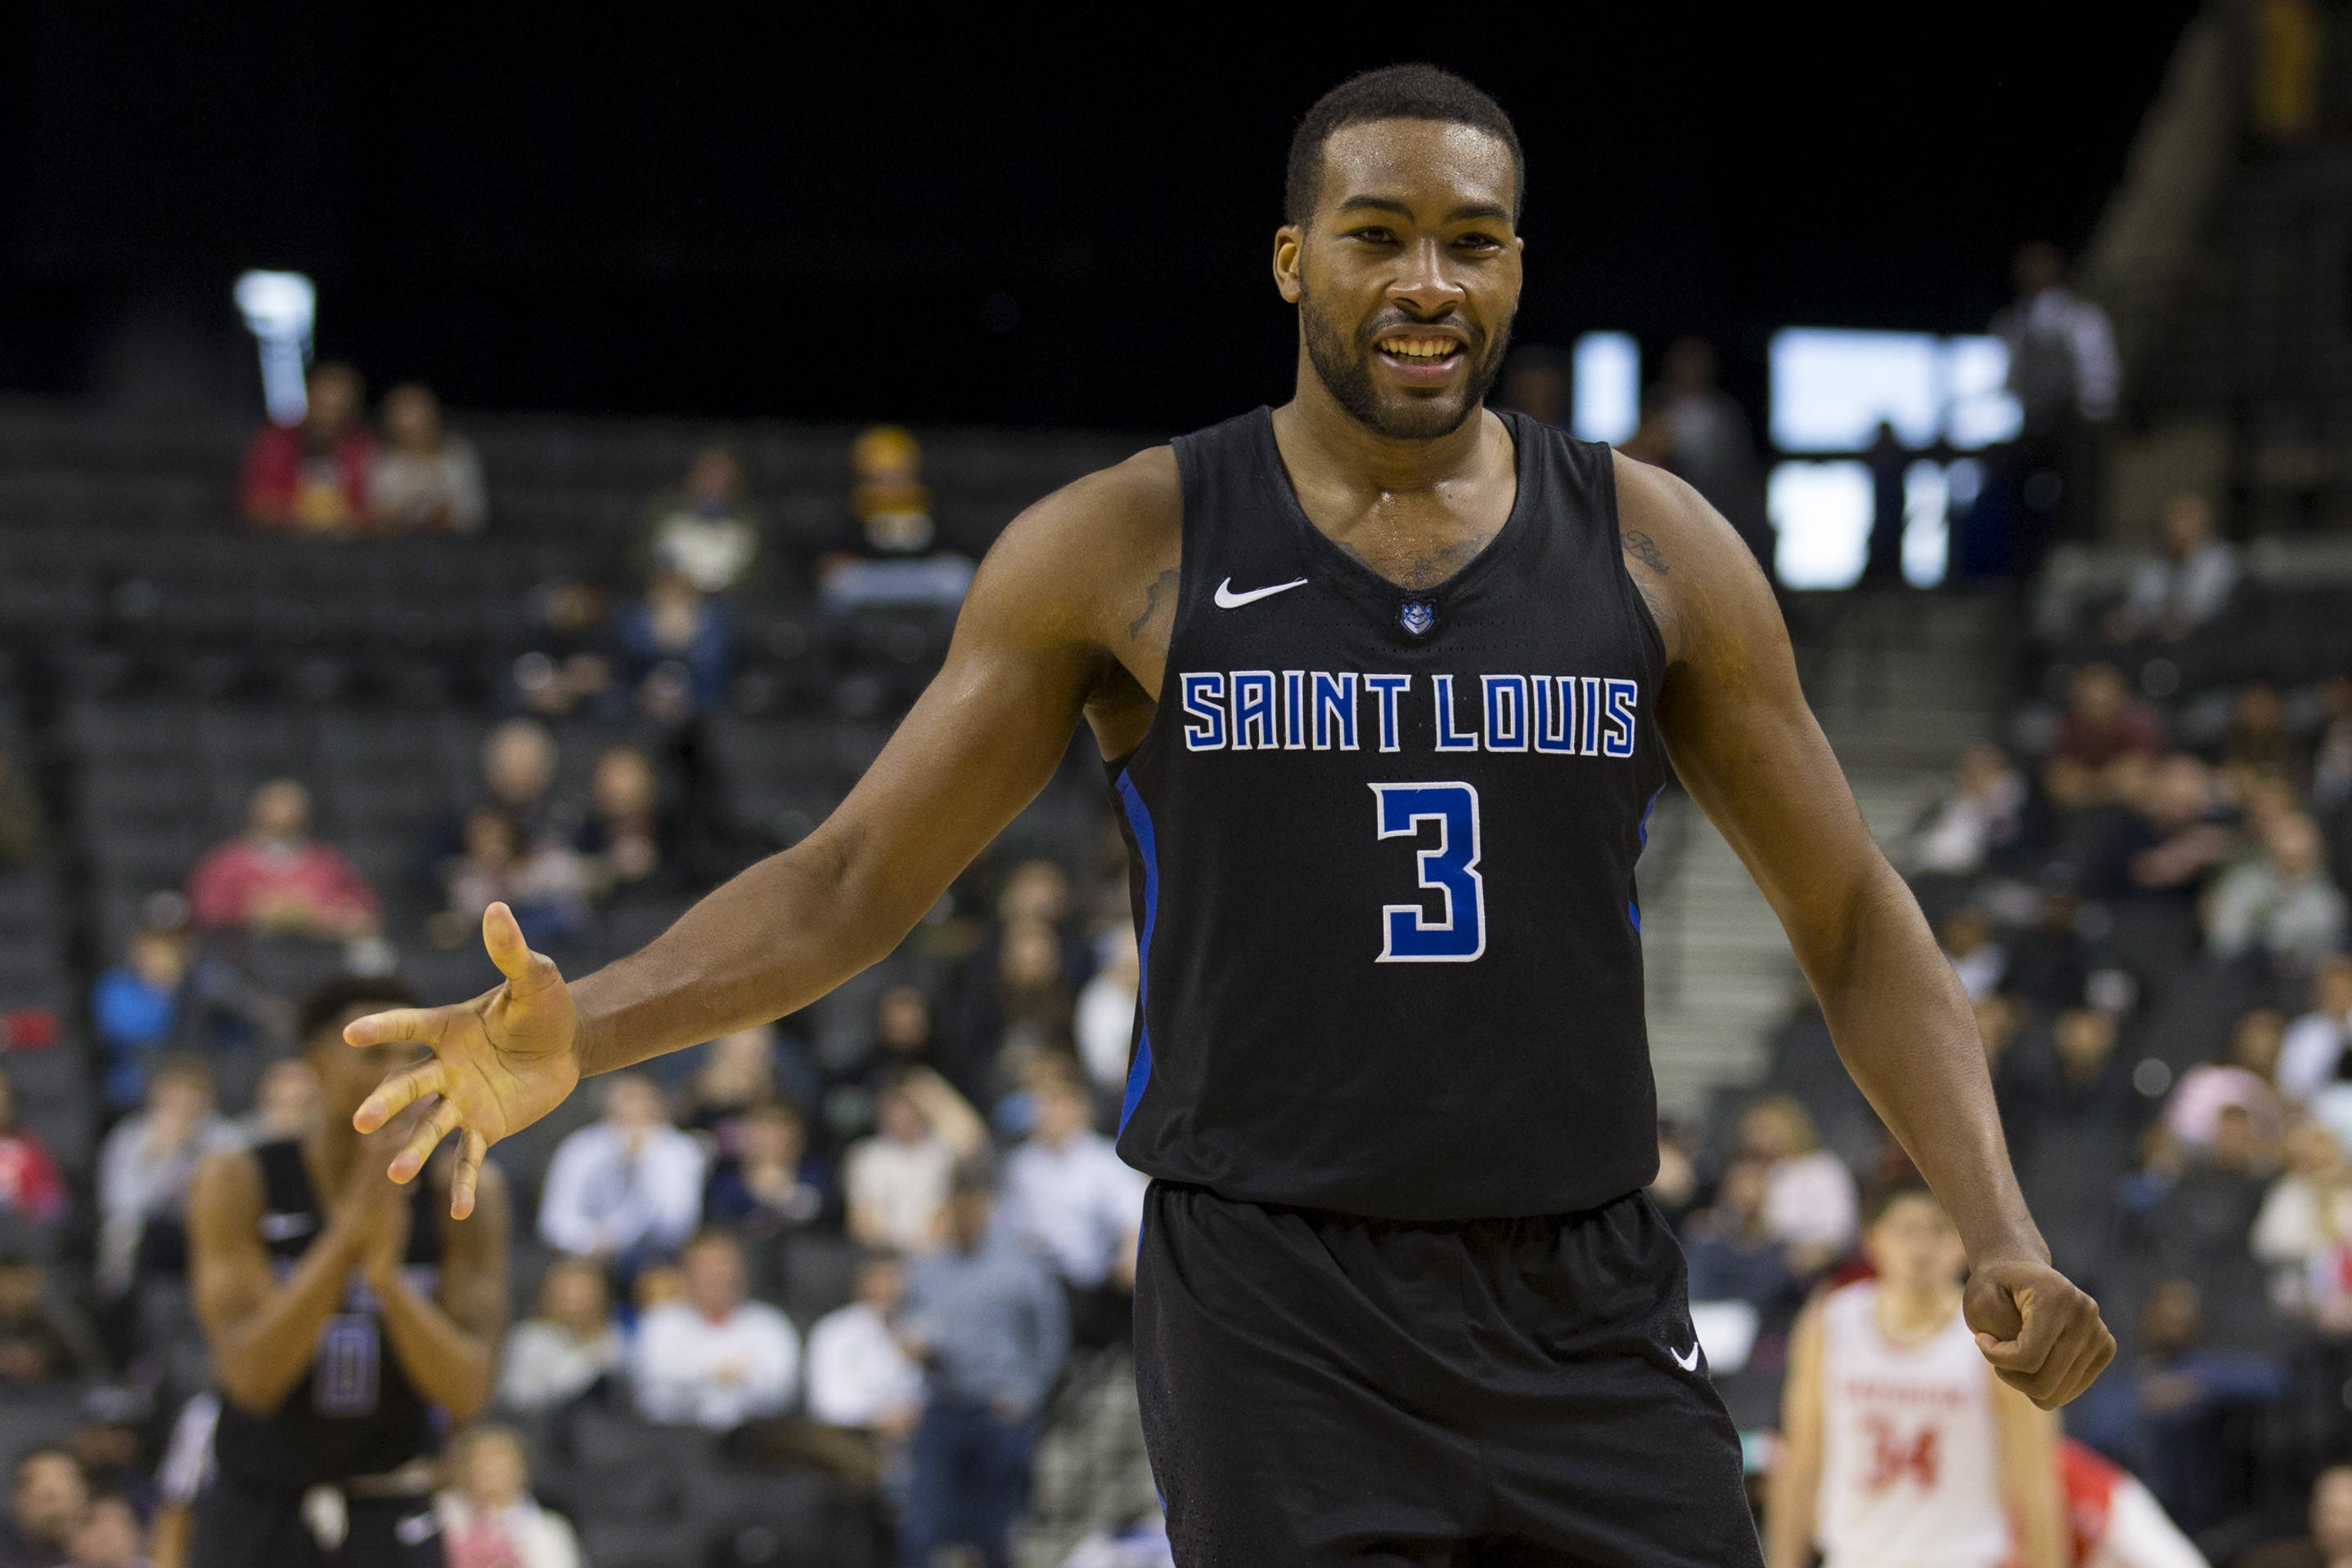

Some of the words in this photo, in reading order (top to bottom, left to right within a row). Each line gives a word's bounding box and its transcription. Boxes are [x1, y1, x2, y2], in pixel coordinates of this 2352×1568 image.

[1180, 670, 1411, 753] SAINT
[1432, 674, 1638, 757] LOUIS
[1367, 781, 1486, 963] 3
[1860, 1411, 1941, 1498] 34
